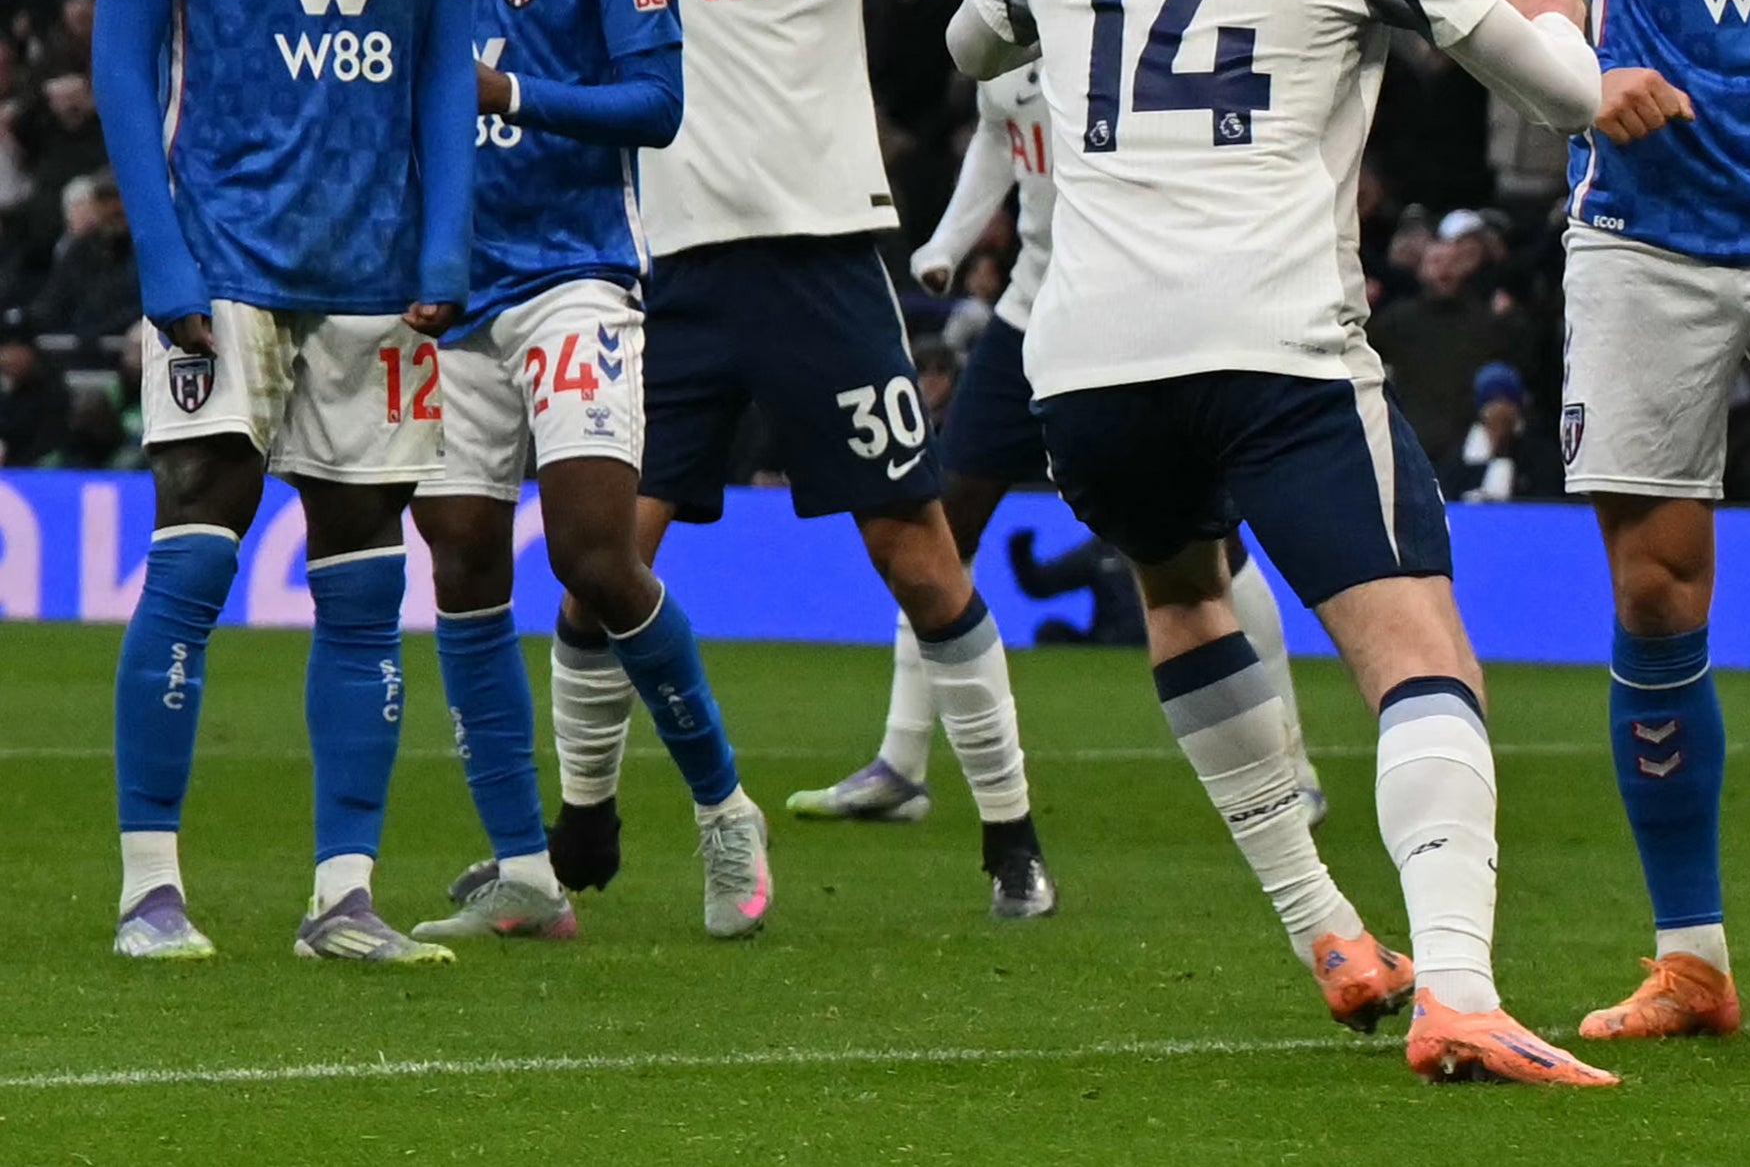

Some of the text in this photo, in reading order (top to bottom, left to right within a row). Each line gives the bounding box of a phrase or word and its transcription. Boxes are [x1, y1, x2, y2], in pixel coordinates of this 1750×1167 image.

[274, 31, 393, 82] W88
[1005, 118, 1047, 174] AI
[379, 342, 442, 423] 12
[524, 333, 599, 419] 24
[836, 375, 926, 460] 30
[163, 642, 188, 709] SAFC
